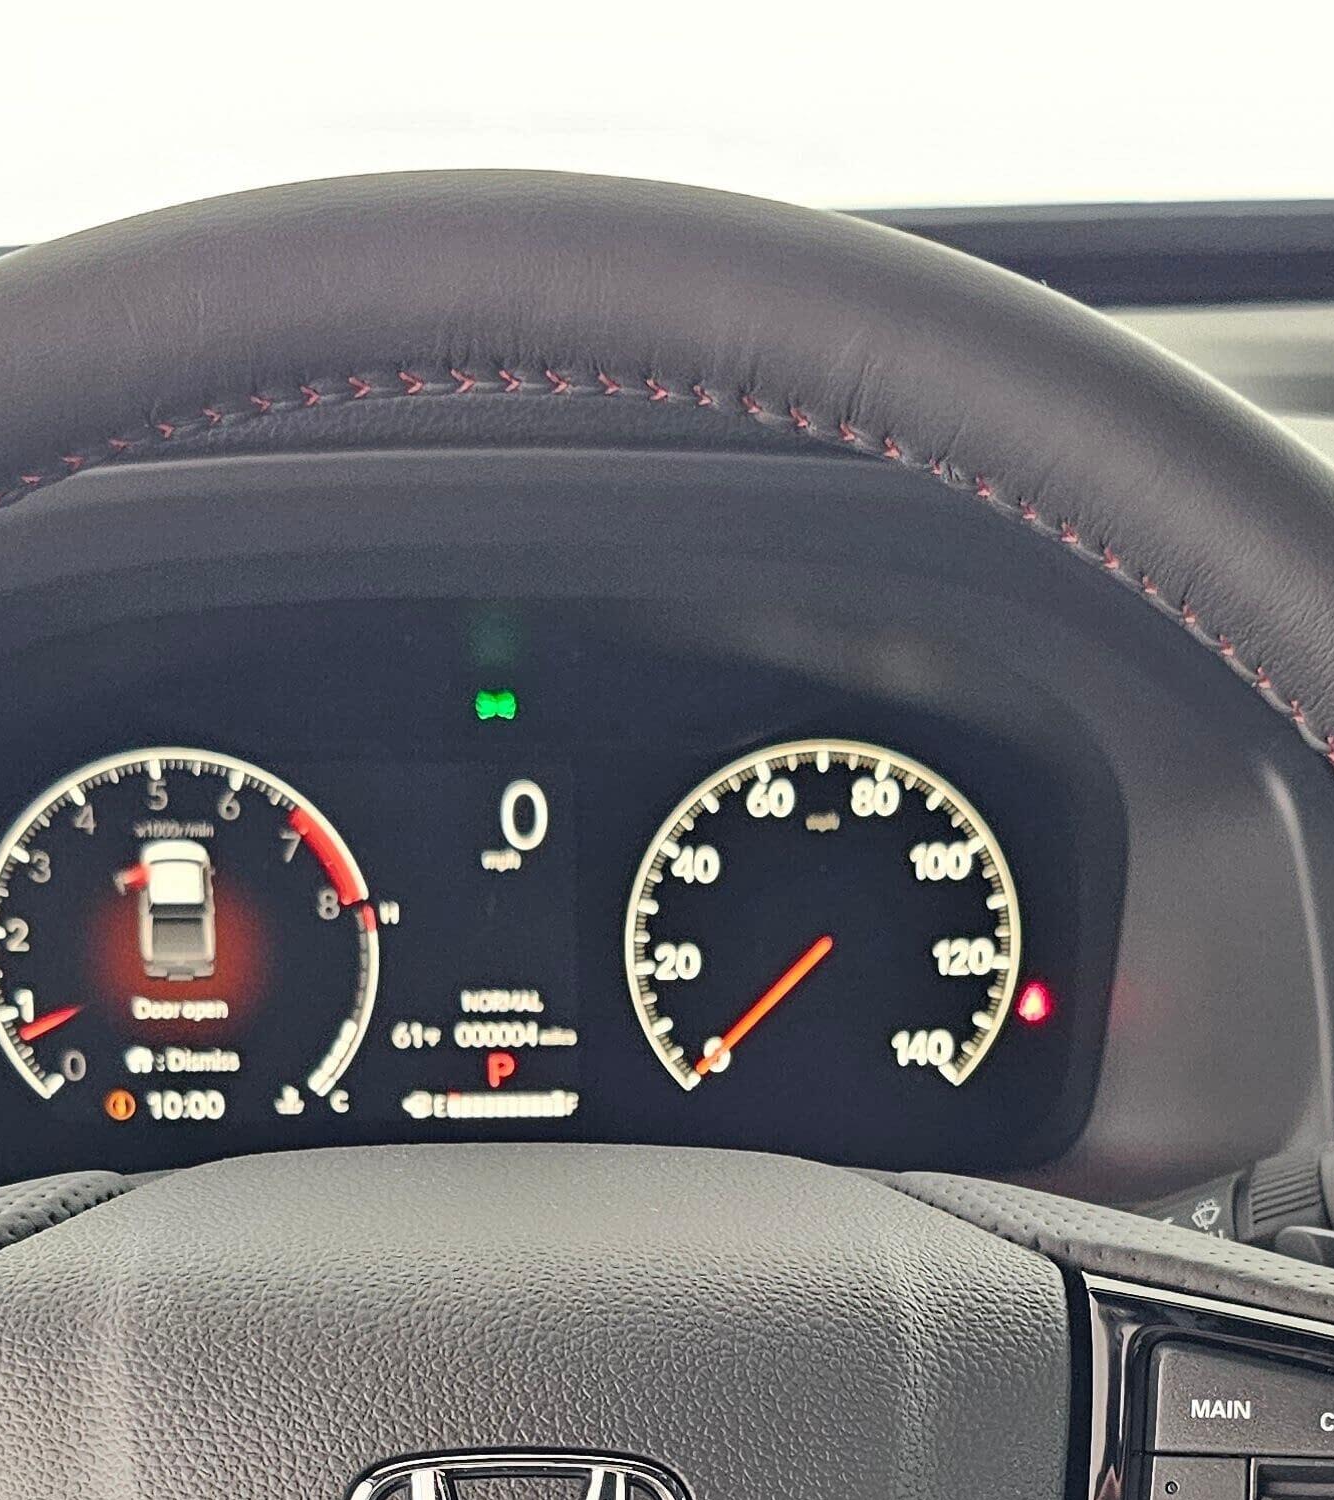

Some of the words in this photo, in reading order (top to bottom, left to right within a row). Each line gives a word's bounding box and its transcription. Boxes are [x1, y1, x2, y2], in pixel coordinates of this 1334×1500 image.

[148, 779, 169, 811] 5
[218, 791, 241, 821] 6
[746, 778, 795, 818] 60
[851, 777, 900, 817] 80
[74, 804, 97, 835] 4
[500, 779, 548, 850] 0
[280, 825, 301, 862] 7
[909, 841, 973, 881] 100
[28, 849, 51, 883] 3
[671, 845, 720, 883] 40
[317, 887, 340, 920] 8
[6, 917, 30, 952] 2
[654, 943, 702, 980] 20
[932, 938, 996, 976] 120
[15, 988, 35, 1023] 1
[131, 996, 181, 1020] Door
[181, 999, 229, 1022] open
[460, 989, 544, 1013] NORMAL
[167, 1048, 240, 1073] Dismiss
[892, 1029, 954, 1067] 140
[62, 1050, 87, 1082] 0
[487, 1052, 515, 1088] P
[147, 1089, 226, 1120] 10:00
[1190, 1399, 1251, 1420] MAIN
